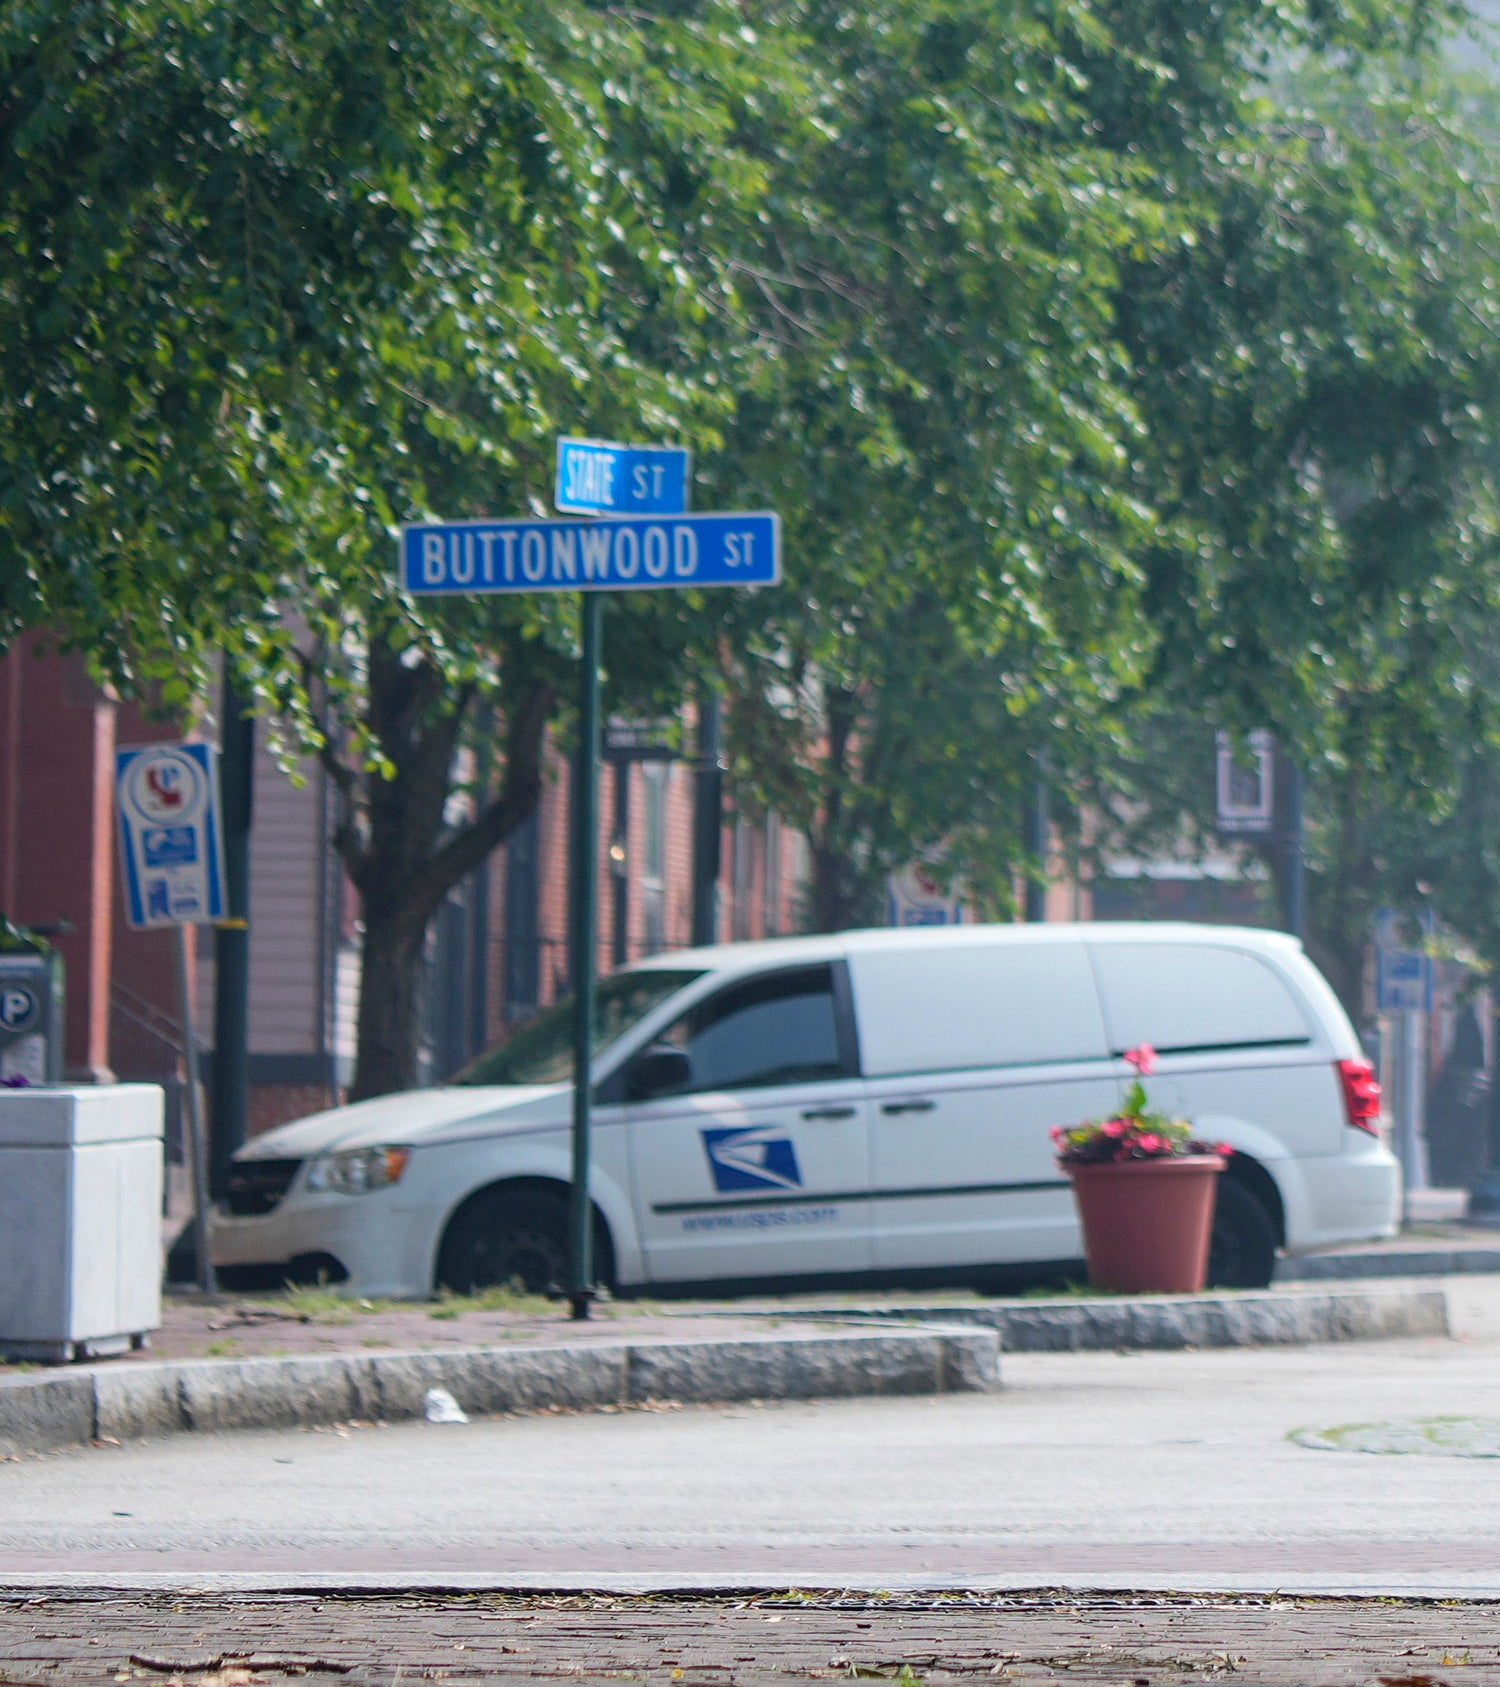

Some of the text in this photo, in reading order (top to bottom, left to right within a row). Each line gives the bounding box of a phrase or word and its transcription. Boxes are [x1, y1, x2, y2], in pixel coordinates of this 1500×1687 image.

[565, 448, 666, 506] STATE ST
[421, 525, 756, 585] BUTTONWOOD ST
[4, 989, 30, 1024] P
